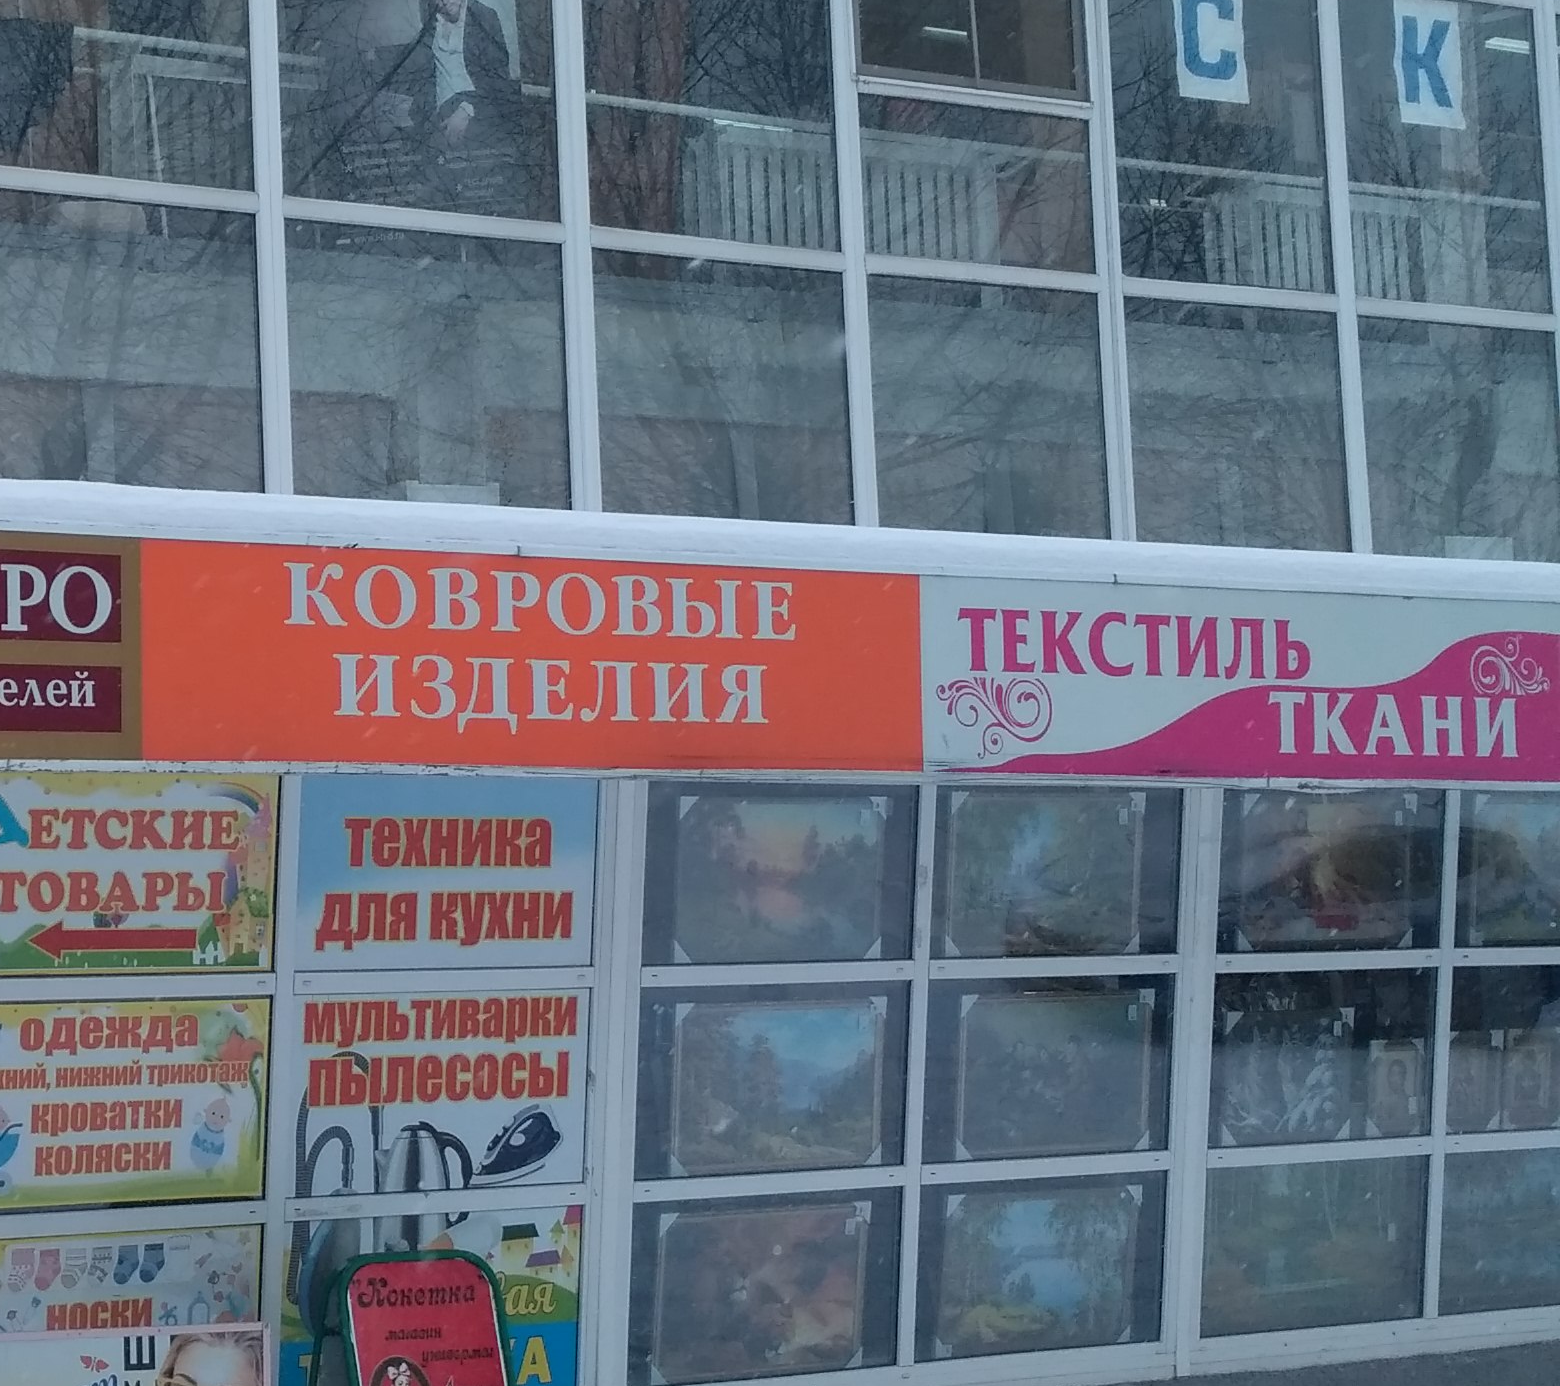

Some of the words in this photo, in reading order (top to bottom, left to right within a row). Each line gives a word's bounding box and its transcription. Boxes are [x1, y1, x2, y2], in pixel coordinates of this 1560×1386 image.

[1401, 15, 1453, 108] К
[284, 560, 797, 641] КОВРОВЫЕ
[958, 607, 1312, 680] ТЕКСТИЛЬ
[334, 653, 769, 735] ИЗДЕЛИЯ
[1268, 691, 1519, 759] ТКАНИ
[345, 817, 553, 868] техника
[315, 891, 416, 950] для
[429, 889, 574, 946] кухни
[19, 1013, 199, 1056] одежда
[303, 996, 577, 1046] мультиварки
[55, 1060, 142, 1088] нижний
[146, 1060, 250, 1088] трикотаж
[307, 1051, 570, 1108] пылесосы
[31, 1098, 183, 1136] кроватки
[33, 1140, 172, 1177] коляски
